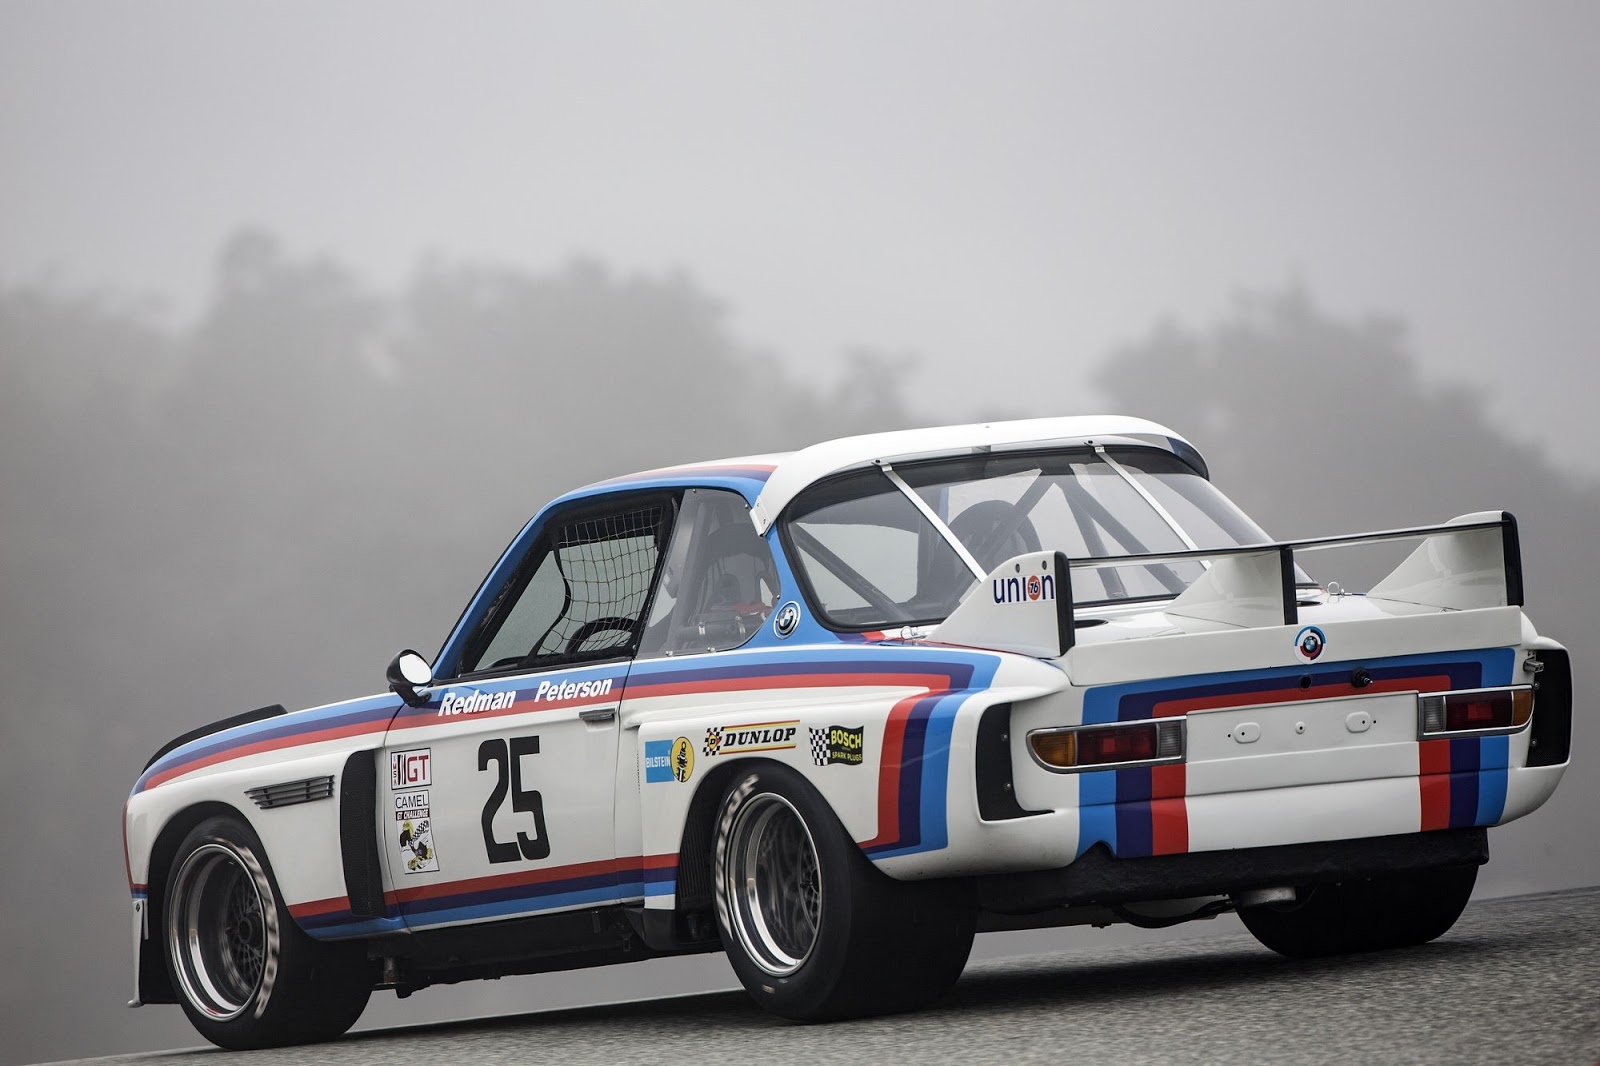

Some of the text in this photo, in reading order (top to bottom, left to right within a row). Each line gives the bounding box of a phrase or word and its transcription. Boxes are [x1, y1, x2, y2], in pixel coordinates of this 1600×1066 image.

[1029, 580, 1039, 596] 76
[437, 678, 613, 717] Redman Peterson
[723, 727, 797, 747] DUNLOP
[831, 729, 862, 749] BOSCH
[645, 755, 671, 769] BILSTEIN
[832, 751, 847, 759] SPARK
[407, 754, 429, 782] GT
[395, 794, 429, 809] CAMEL
[478, 735, 551, 864] 25
[403, 809, 429, 819] CHALLENGE
